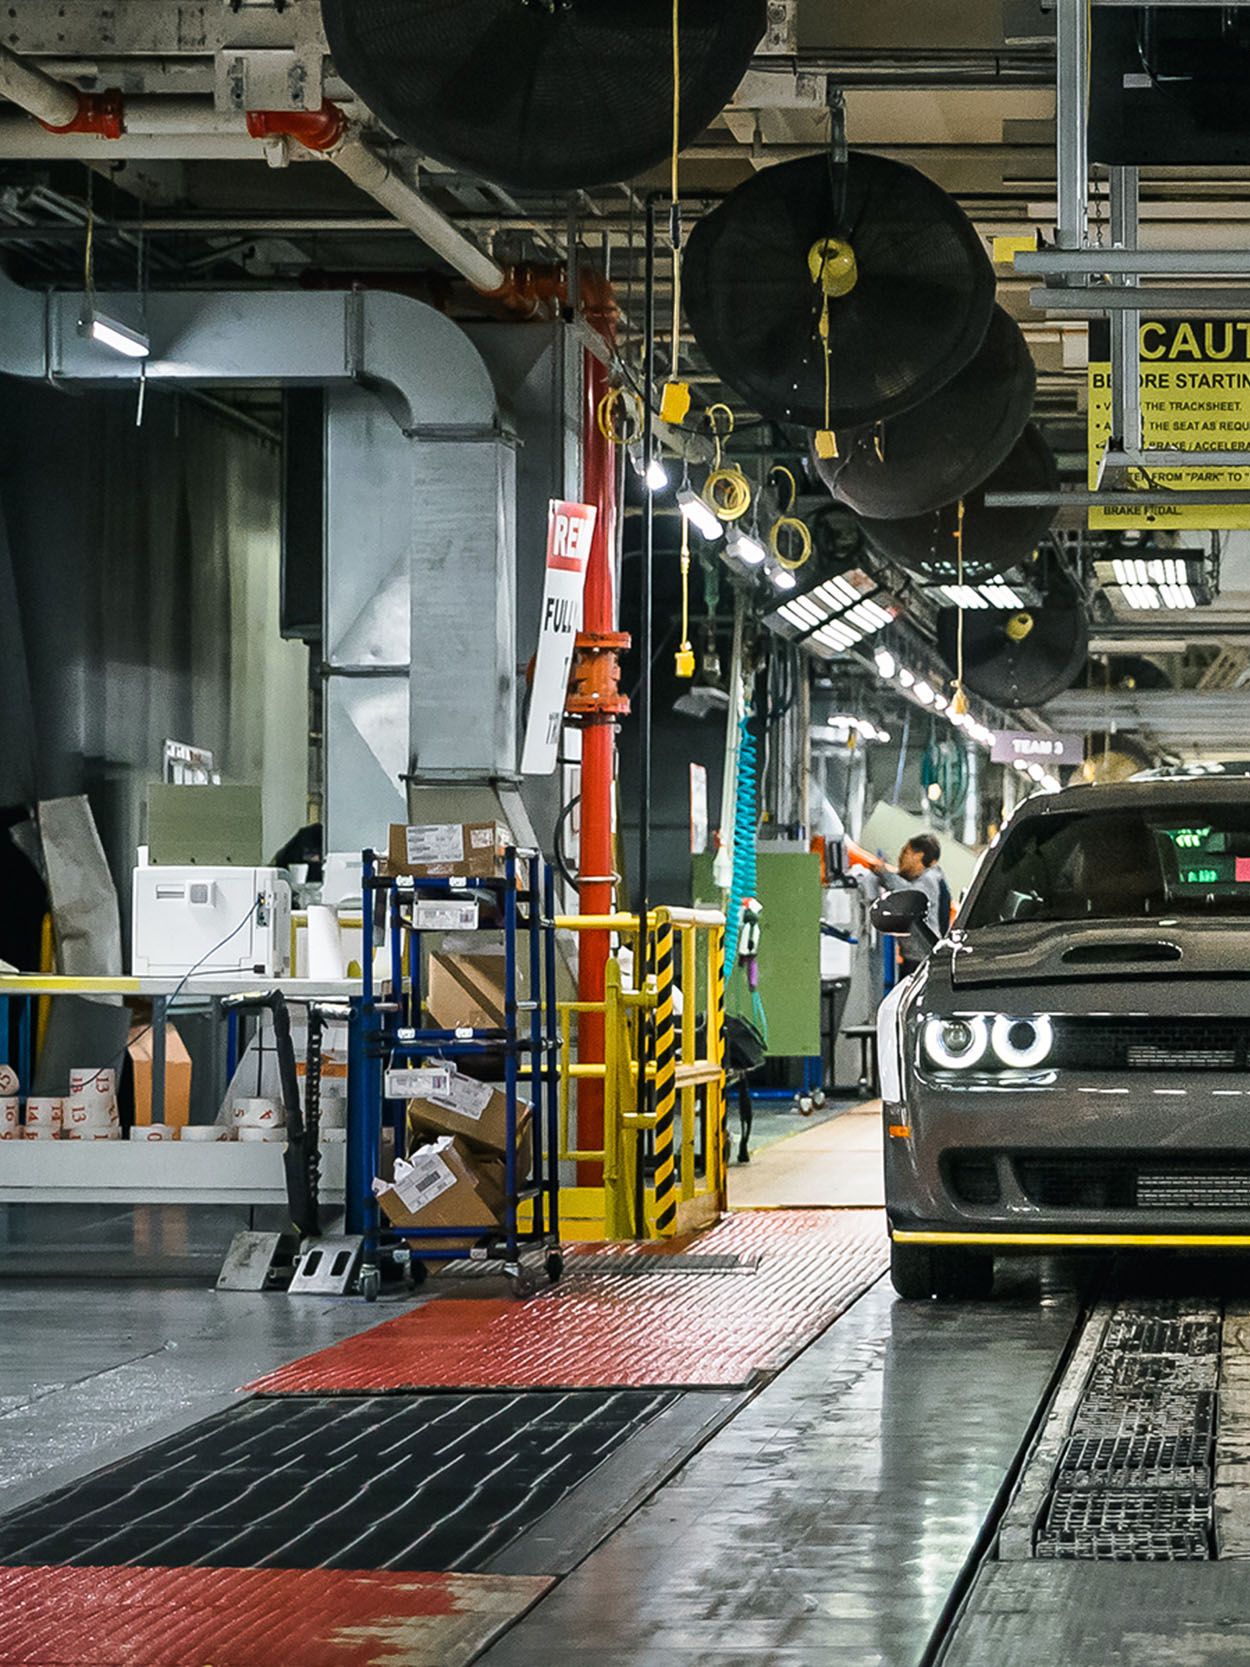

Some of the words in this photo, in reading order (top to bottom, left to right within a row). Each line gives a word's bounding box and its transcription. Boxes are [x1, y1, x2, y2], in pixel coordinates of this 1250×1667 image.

[1146, 402, 1166, 411] THE
[1169, 402, 1243, 411] TRACKSHEET.
[1149, 422, 1170, 431] THE
[1172, 422, 1200, 431] SEAT
[1201, 422, 1216, 431] AS
[1151, 472, 1183, 482] FROM
[1228, 472, 1242, 482] TO
